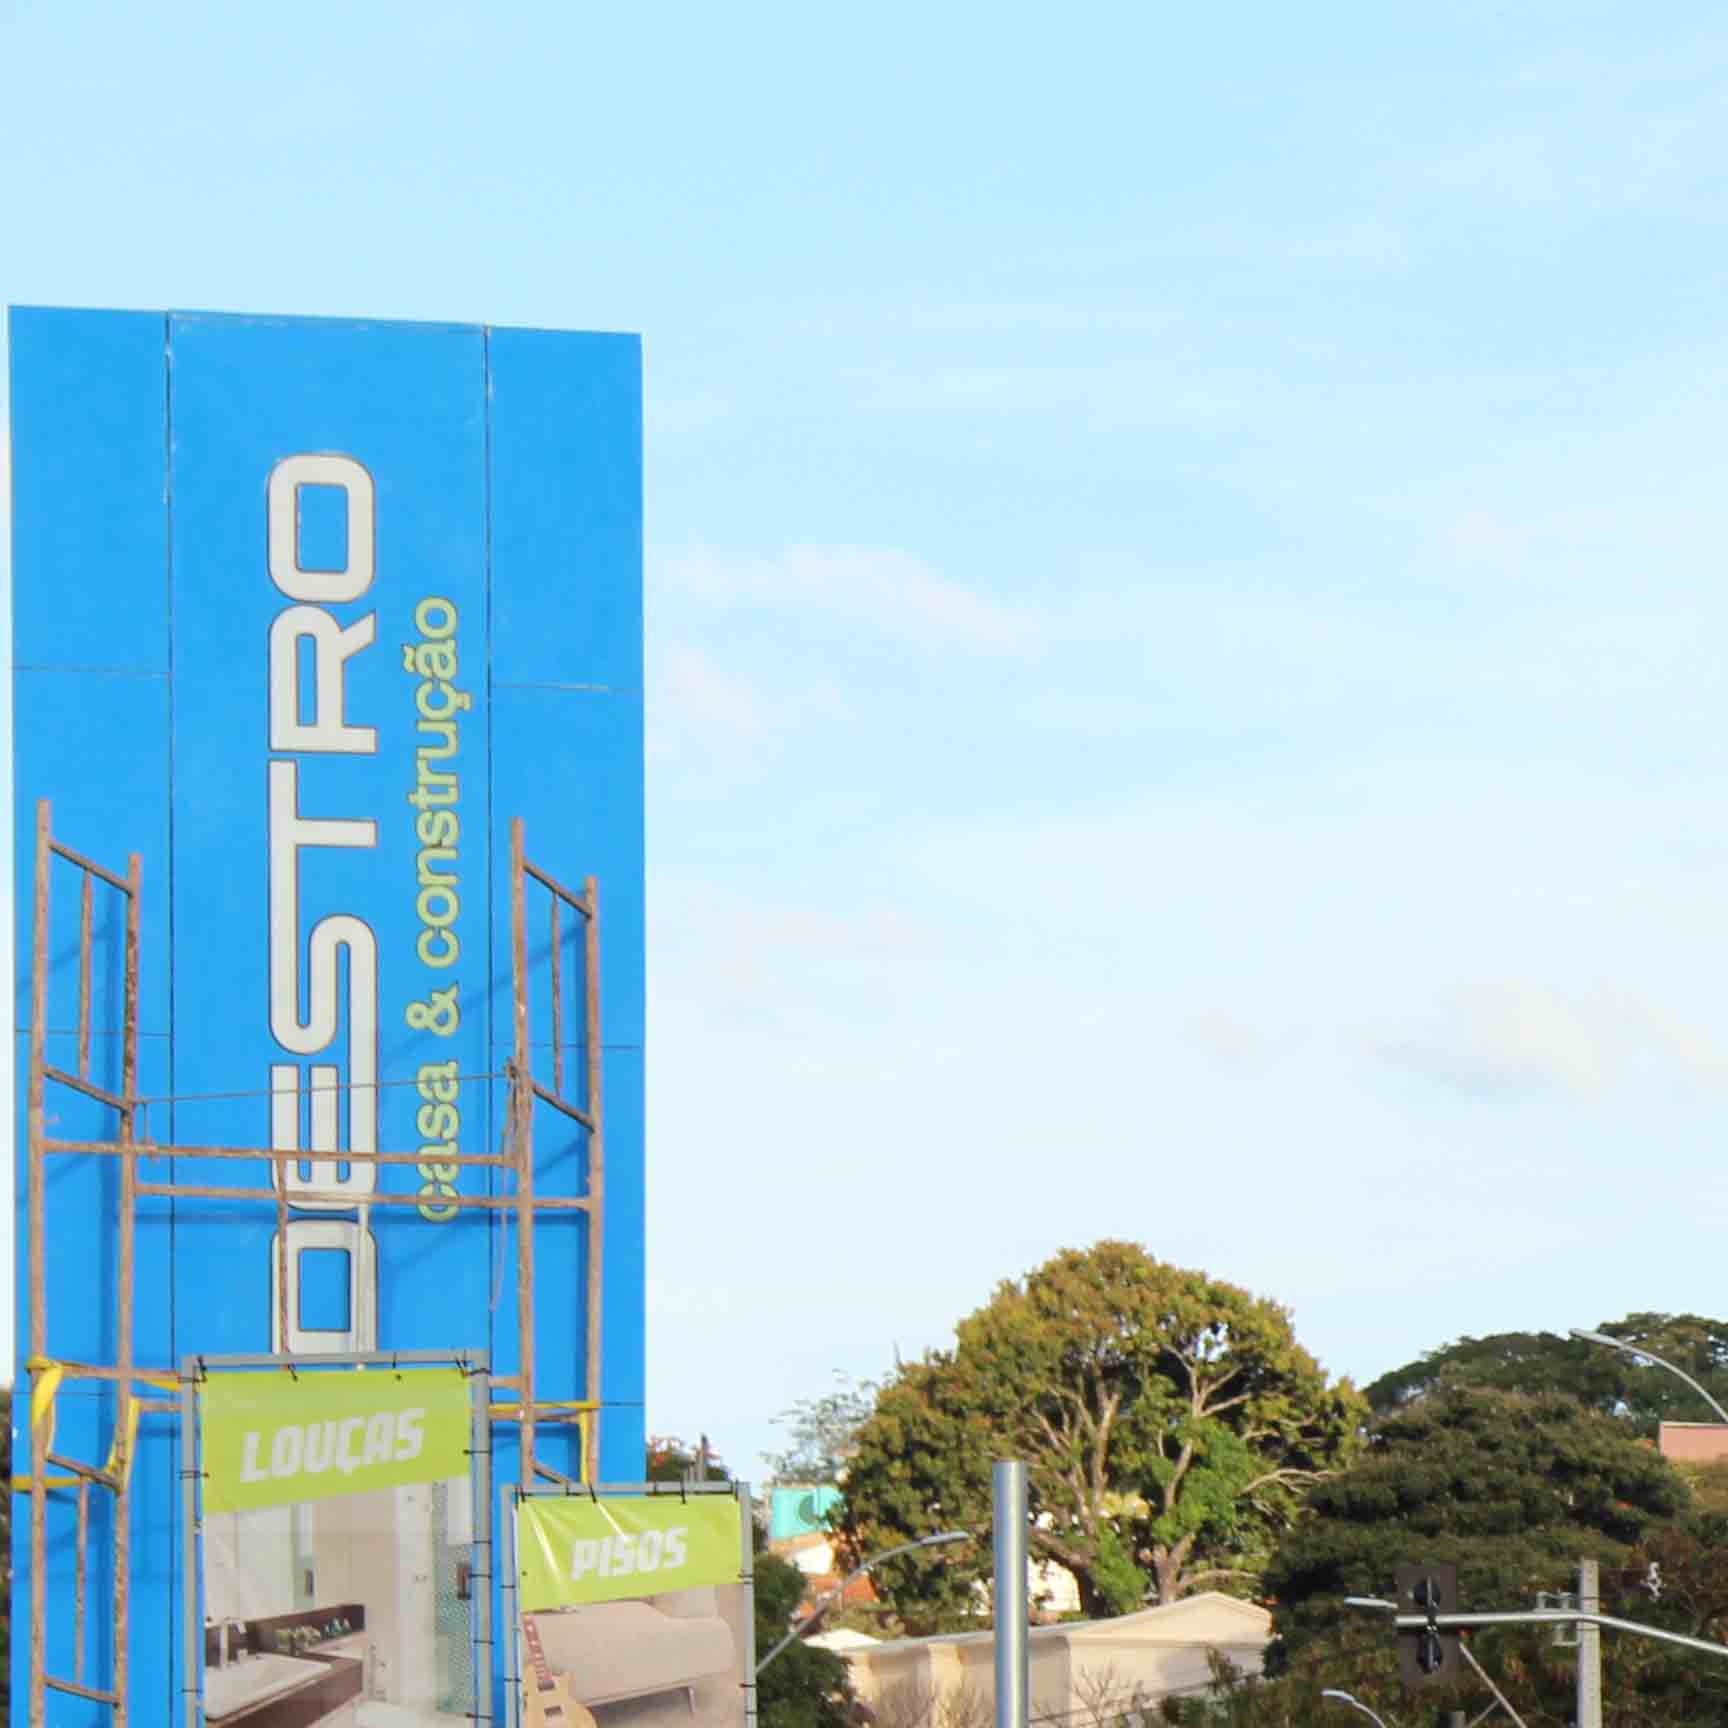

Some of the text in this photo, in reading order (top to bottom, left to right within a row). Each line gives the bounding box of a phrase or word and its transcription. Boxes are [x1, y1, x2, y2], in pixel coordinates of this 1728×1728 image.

[268, 452, 378, 1354] DESTRO
[402, 595, 474, 1223] casa & construção
[239, 1407, 425, 1483] LOUÇAS
[571, 1526, 689, 1581] PISOS
